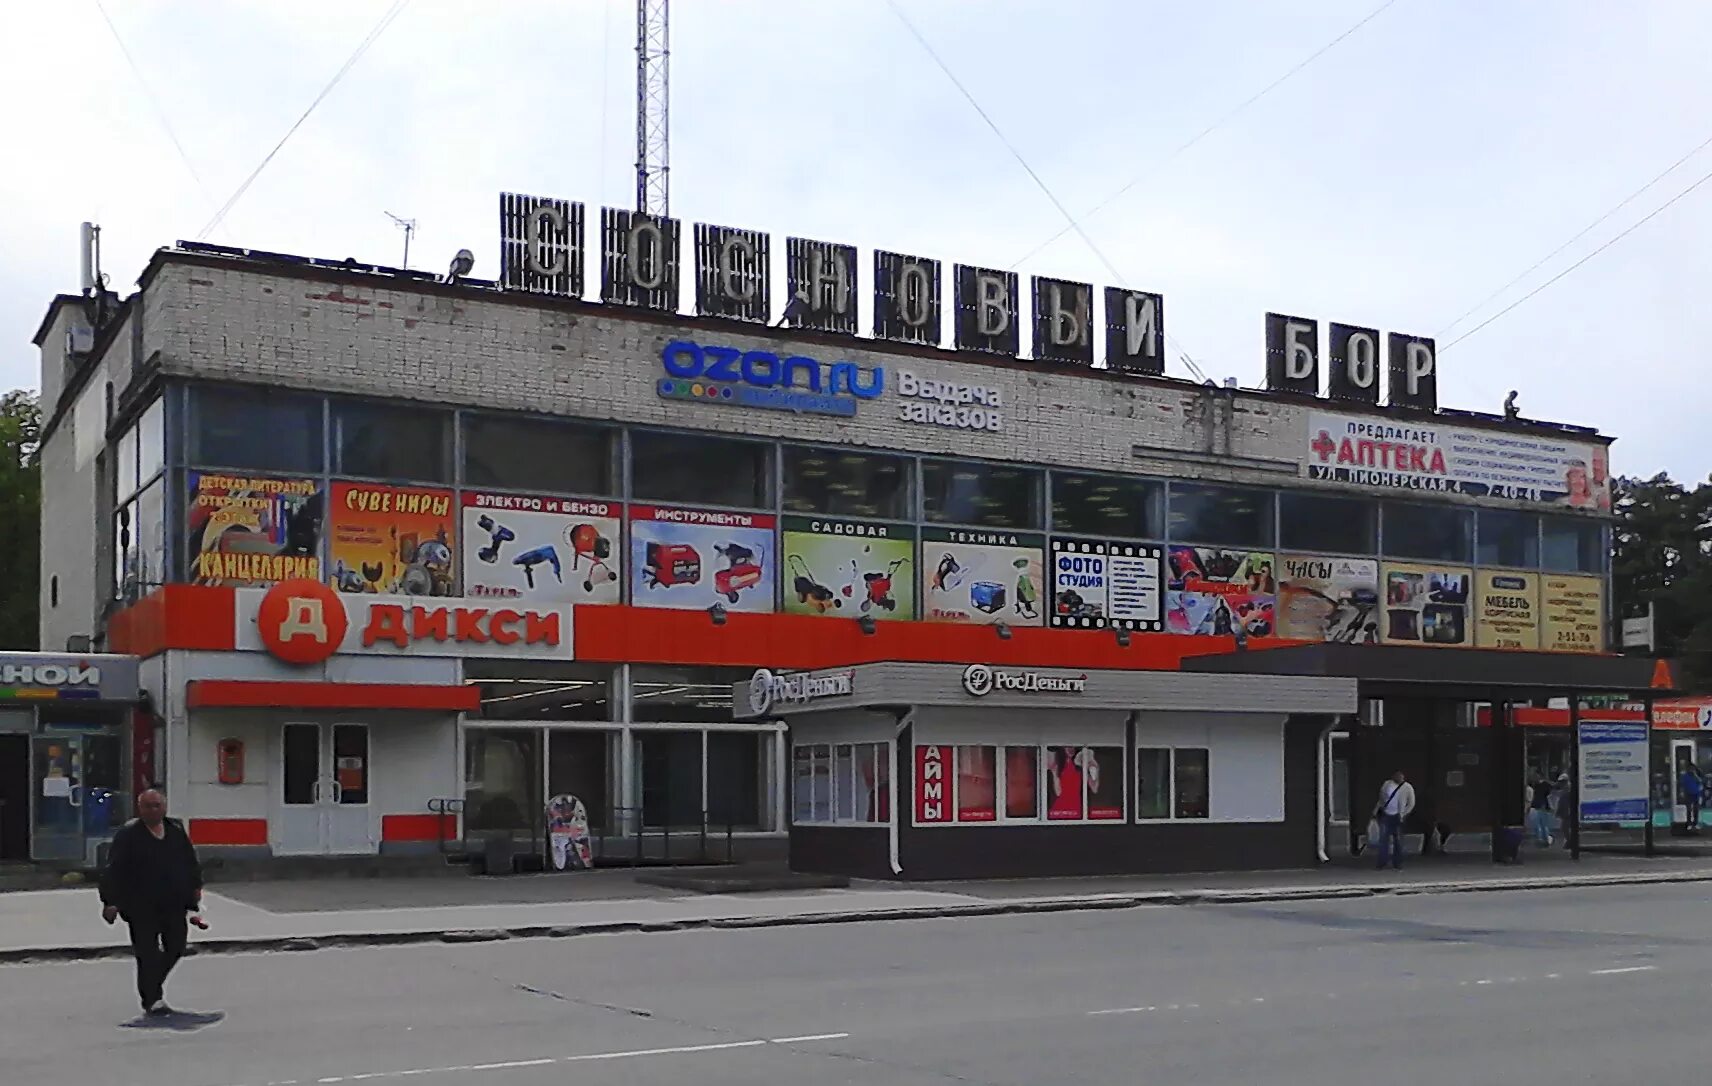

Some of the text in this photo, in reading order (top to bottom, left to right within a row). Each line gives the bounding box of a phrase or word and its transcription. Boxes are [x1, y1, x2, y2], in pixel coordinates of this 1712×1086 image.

[662, 339, 884, 398] ozon.ru
[1284, 321, 1433, 395] БОР
[898, 369, 1001, 406] Выдача
[898, 401, 1001, 431] заказов
[1337, 436, 1447, 476] АПТЕКА
[199, 475, 248, 491] ДЕТСКАЯ
[1348, 469, 1447, 492] ПИОНЕРСКАЯ
[476, 494, 608, 516] ЭЛЕКТРО И БЕНЗО
[654, 508, 752, 526] ИНСТРУМЕНТЫ
[811, 521, 887, 537] САДОВАЯ
[949, 531, 1018, 546] ТЕХНИКА
[199, 552, 318, 583] КАНЦЕЛЯРИЯ
[1058, 556, 1103, 574] ФОТО
[1284, 560, 1333, 579] ЧАСЫ
[1058, 573, 1103, 588] СТУДИЯ
[1484, 595, 1530, 609] МЕБЕЛЬ
[0, 659, 101, 686] НОЙ
[993, 670, 1086, 693] РосДеньги
